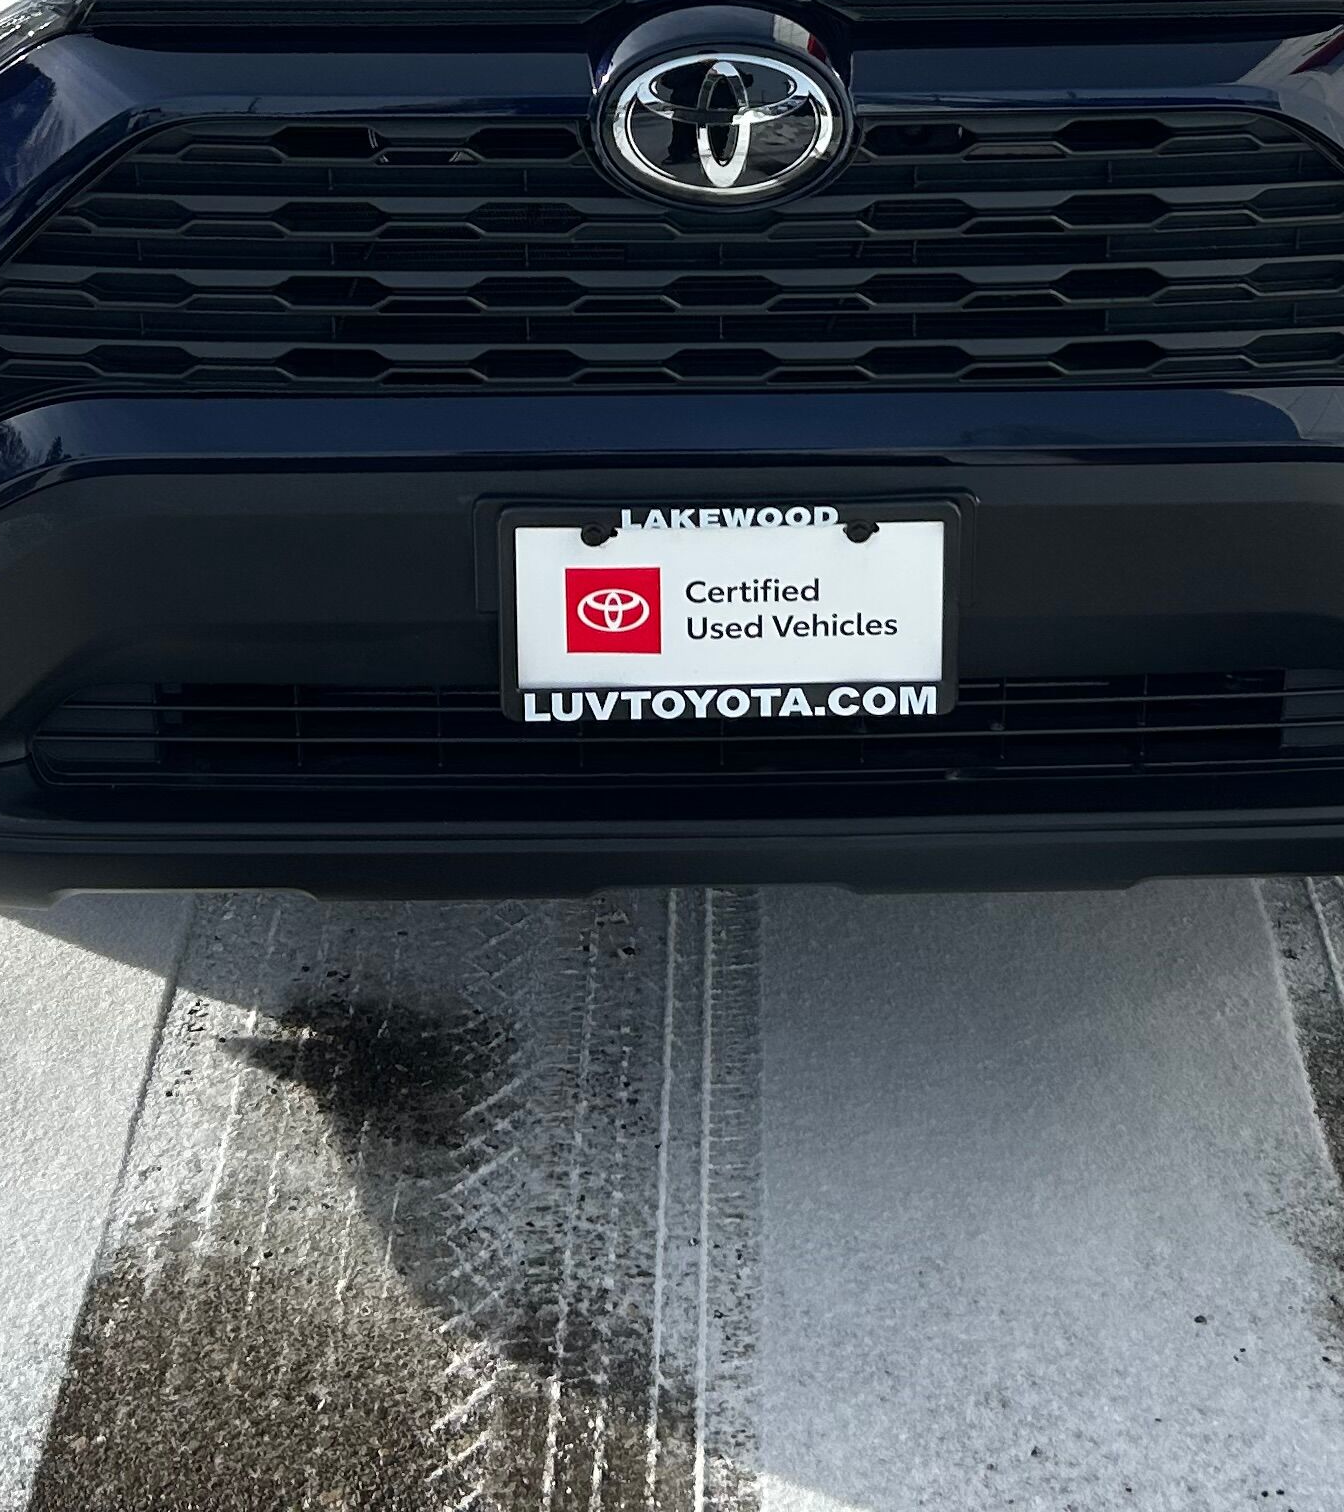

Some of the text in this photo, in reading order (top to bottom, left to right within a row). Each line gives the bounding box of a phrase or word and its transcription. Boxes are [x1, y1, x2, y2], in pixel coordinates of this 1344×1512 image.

[621, 506, 840, 530] LAKEWOOD
[685, 578, 820, 604] Certified
[685, 613, 899, 640] Used Vehicles
[523, 686, 938, 723] LUVTOYOTA.COM
